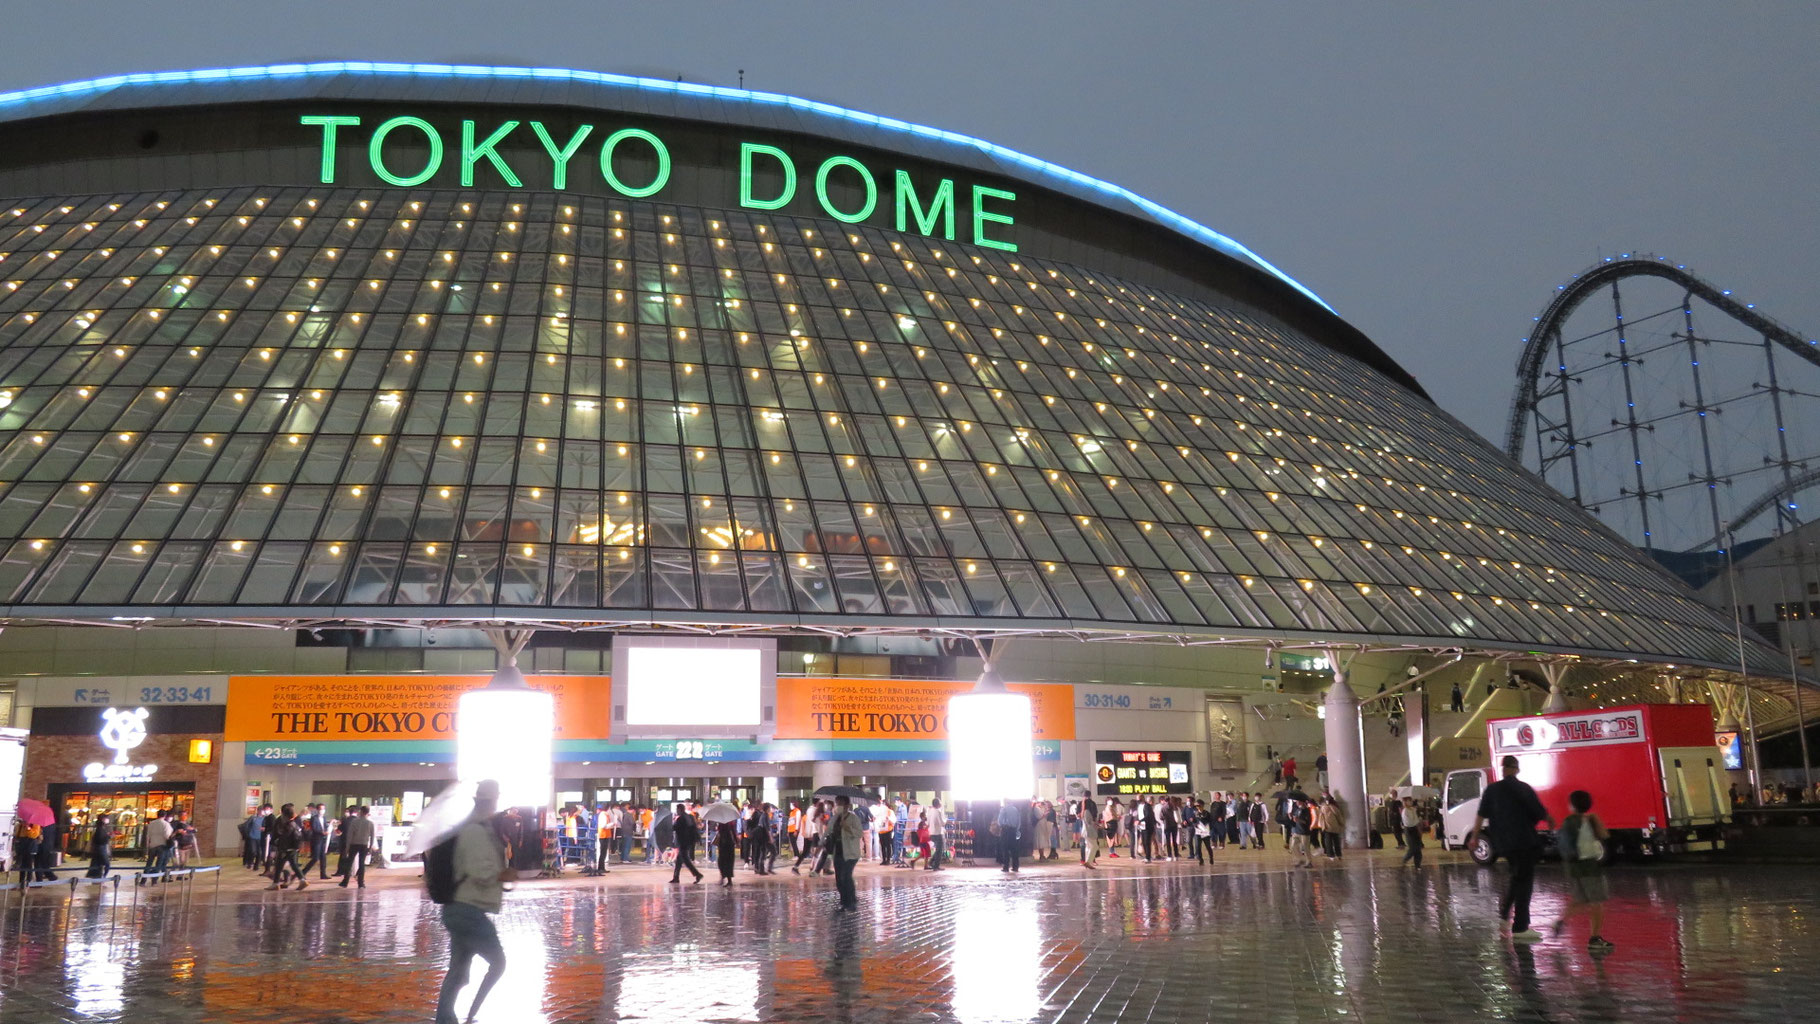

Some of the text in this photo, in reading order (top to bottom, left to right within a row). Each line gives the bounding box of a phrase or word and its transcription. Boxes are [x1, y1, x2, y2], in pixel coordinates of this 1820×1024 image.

[300, 116, 1018, 252] TOKYO DOME
[1313, 657, 1330, 670] 31
[271, 712, 328, 733] THE
[335, 712, 426, 733] TOKYO
[811, 712, 860, 732] THE
[865, 713, 938, 733] TOKYO
[1498, 721, 1593, 748] ASALL
[264, 747, 281, 759] 23
[656, 743, 674, 751] ゲート
[705, 743, 722, 751] ゲート
[1035, 745, 1046, 755] 21
[1116, 767, 1136, 779] GIANTS
[1134, 784, 1151, 793] PLAY
[1152, 784, 1167, 793] BALL
